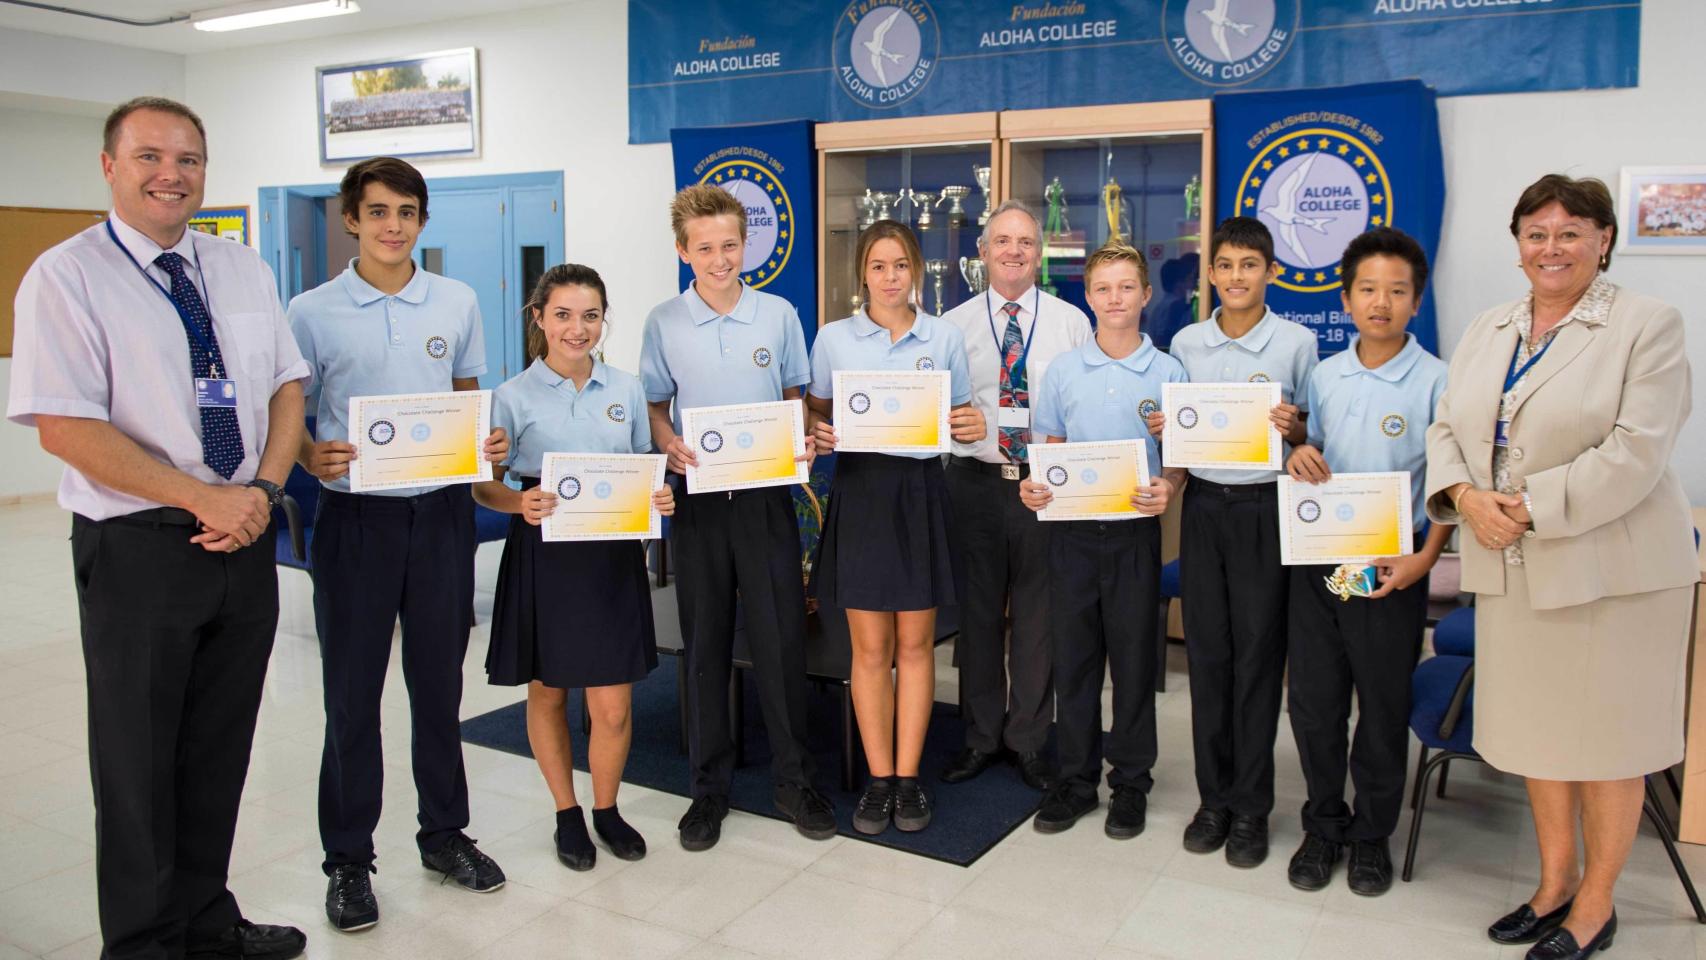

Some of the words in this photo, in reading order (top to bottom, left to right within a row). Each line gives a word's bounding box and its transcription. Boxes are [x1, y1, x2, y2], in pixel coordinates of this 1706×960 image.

[1011, 1, 1086, 21] Fundación
[980, 28, 1036, 48] ALOHA
[1038, 20, 1117, 42] COLLEGE
[699, 35, 756, 54] Fundación
[1172, 36, 1214, 77] ALOHA
[1220, 28, 1288, 79] COLLEGE
[674, 59, 719, 76] ALOHA
[720, 52, 781, 72] COLLEGE
[841, 65, 874, 101] ALOHA
[879, 58, 931, 102] COLLEGE
[1303, 186, 1353, 198] ALOHA
[745, 206, 767, 216] OHA
[1298, 199, 1362, 212] COLLEGE
[744, 216, 773, 227] LLEGE
